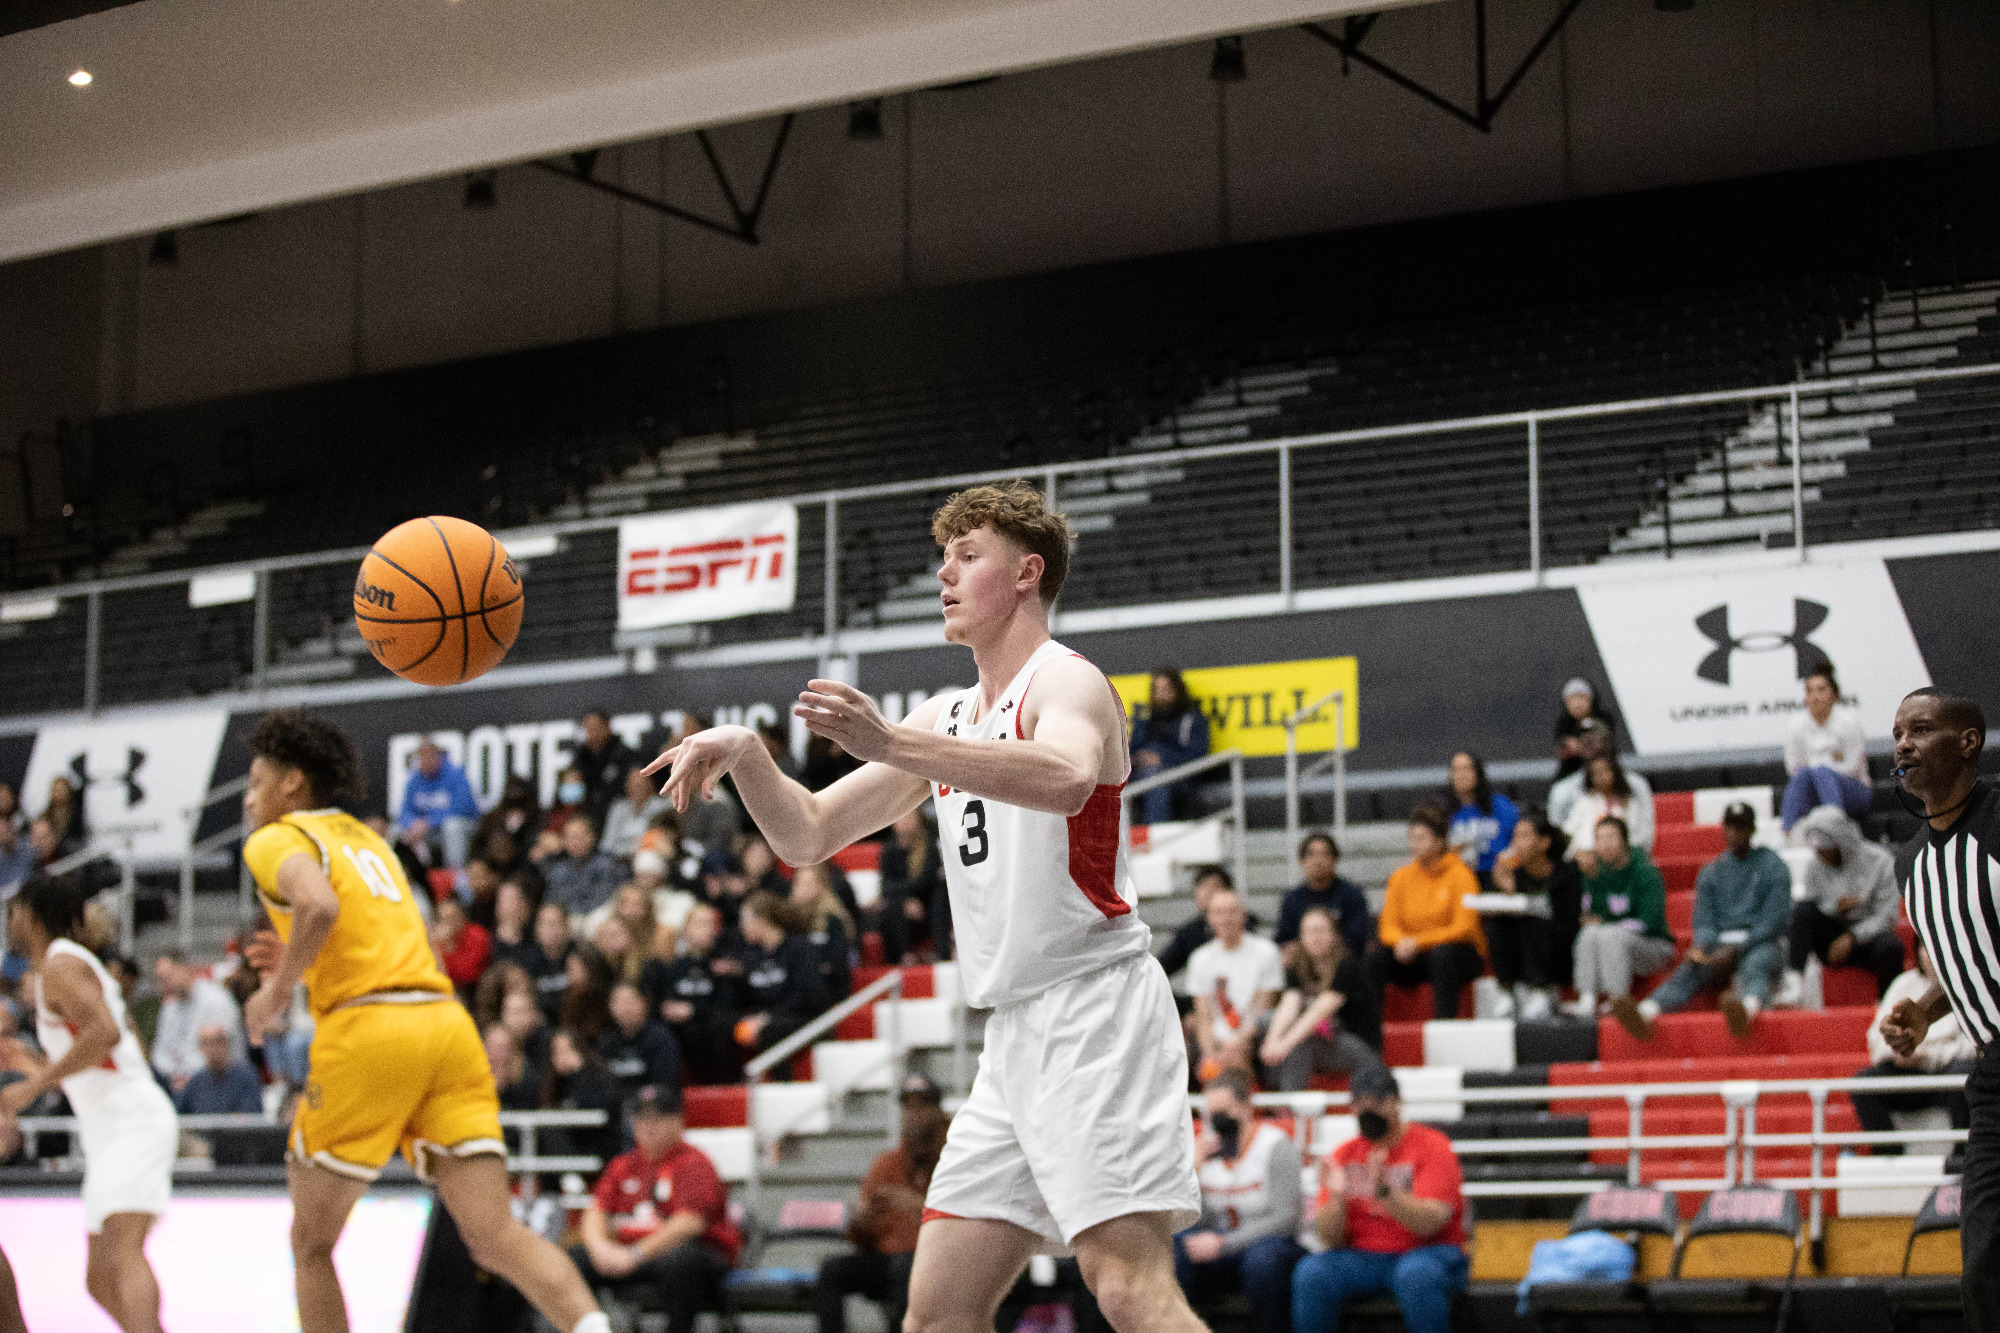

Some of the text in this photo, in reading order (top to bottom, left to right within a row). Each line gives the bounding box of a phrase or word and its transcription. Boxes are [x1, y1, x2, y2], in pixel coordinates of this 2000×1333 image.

[627, 534, 786, 595] ESPN
[1670, 694, 1860, 721] UNDER ARMR
[959, 800, 988, 866] 3
[342, 844, 402, 902] 10
